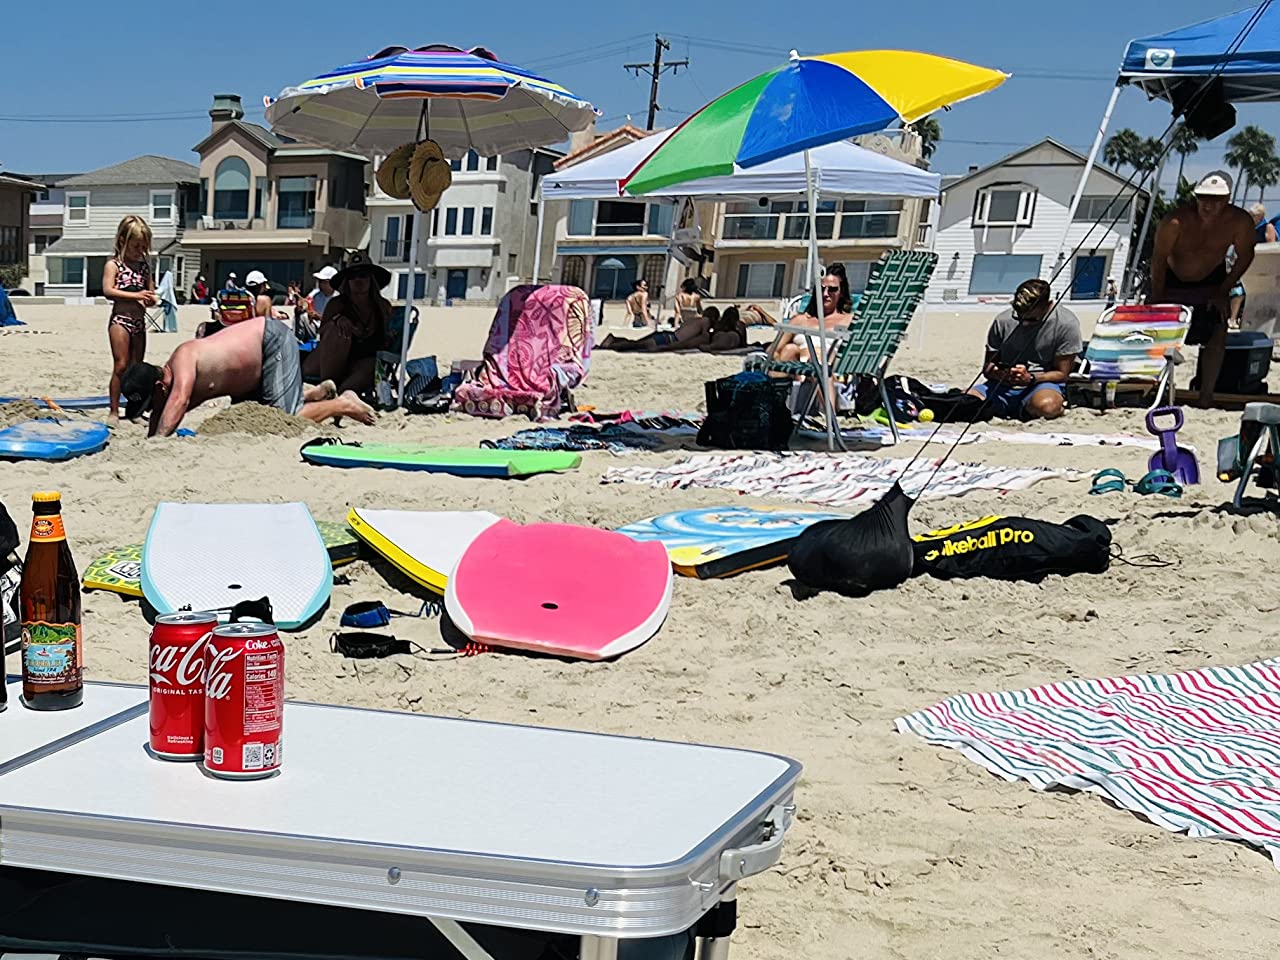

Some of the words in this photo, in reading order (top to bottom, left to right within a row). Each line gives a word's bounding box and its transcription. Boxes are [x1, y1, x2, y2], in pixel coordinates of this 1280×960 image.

[999, 527, 1034, 545] Pro
[245, 639, 268, 650] Coke
[152, 686, 185, 695] ORIGINAL
